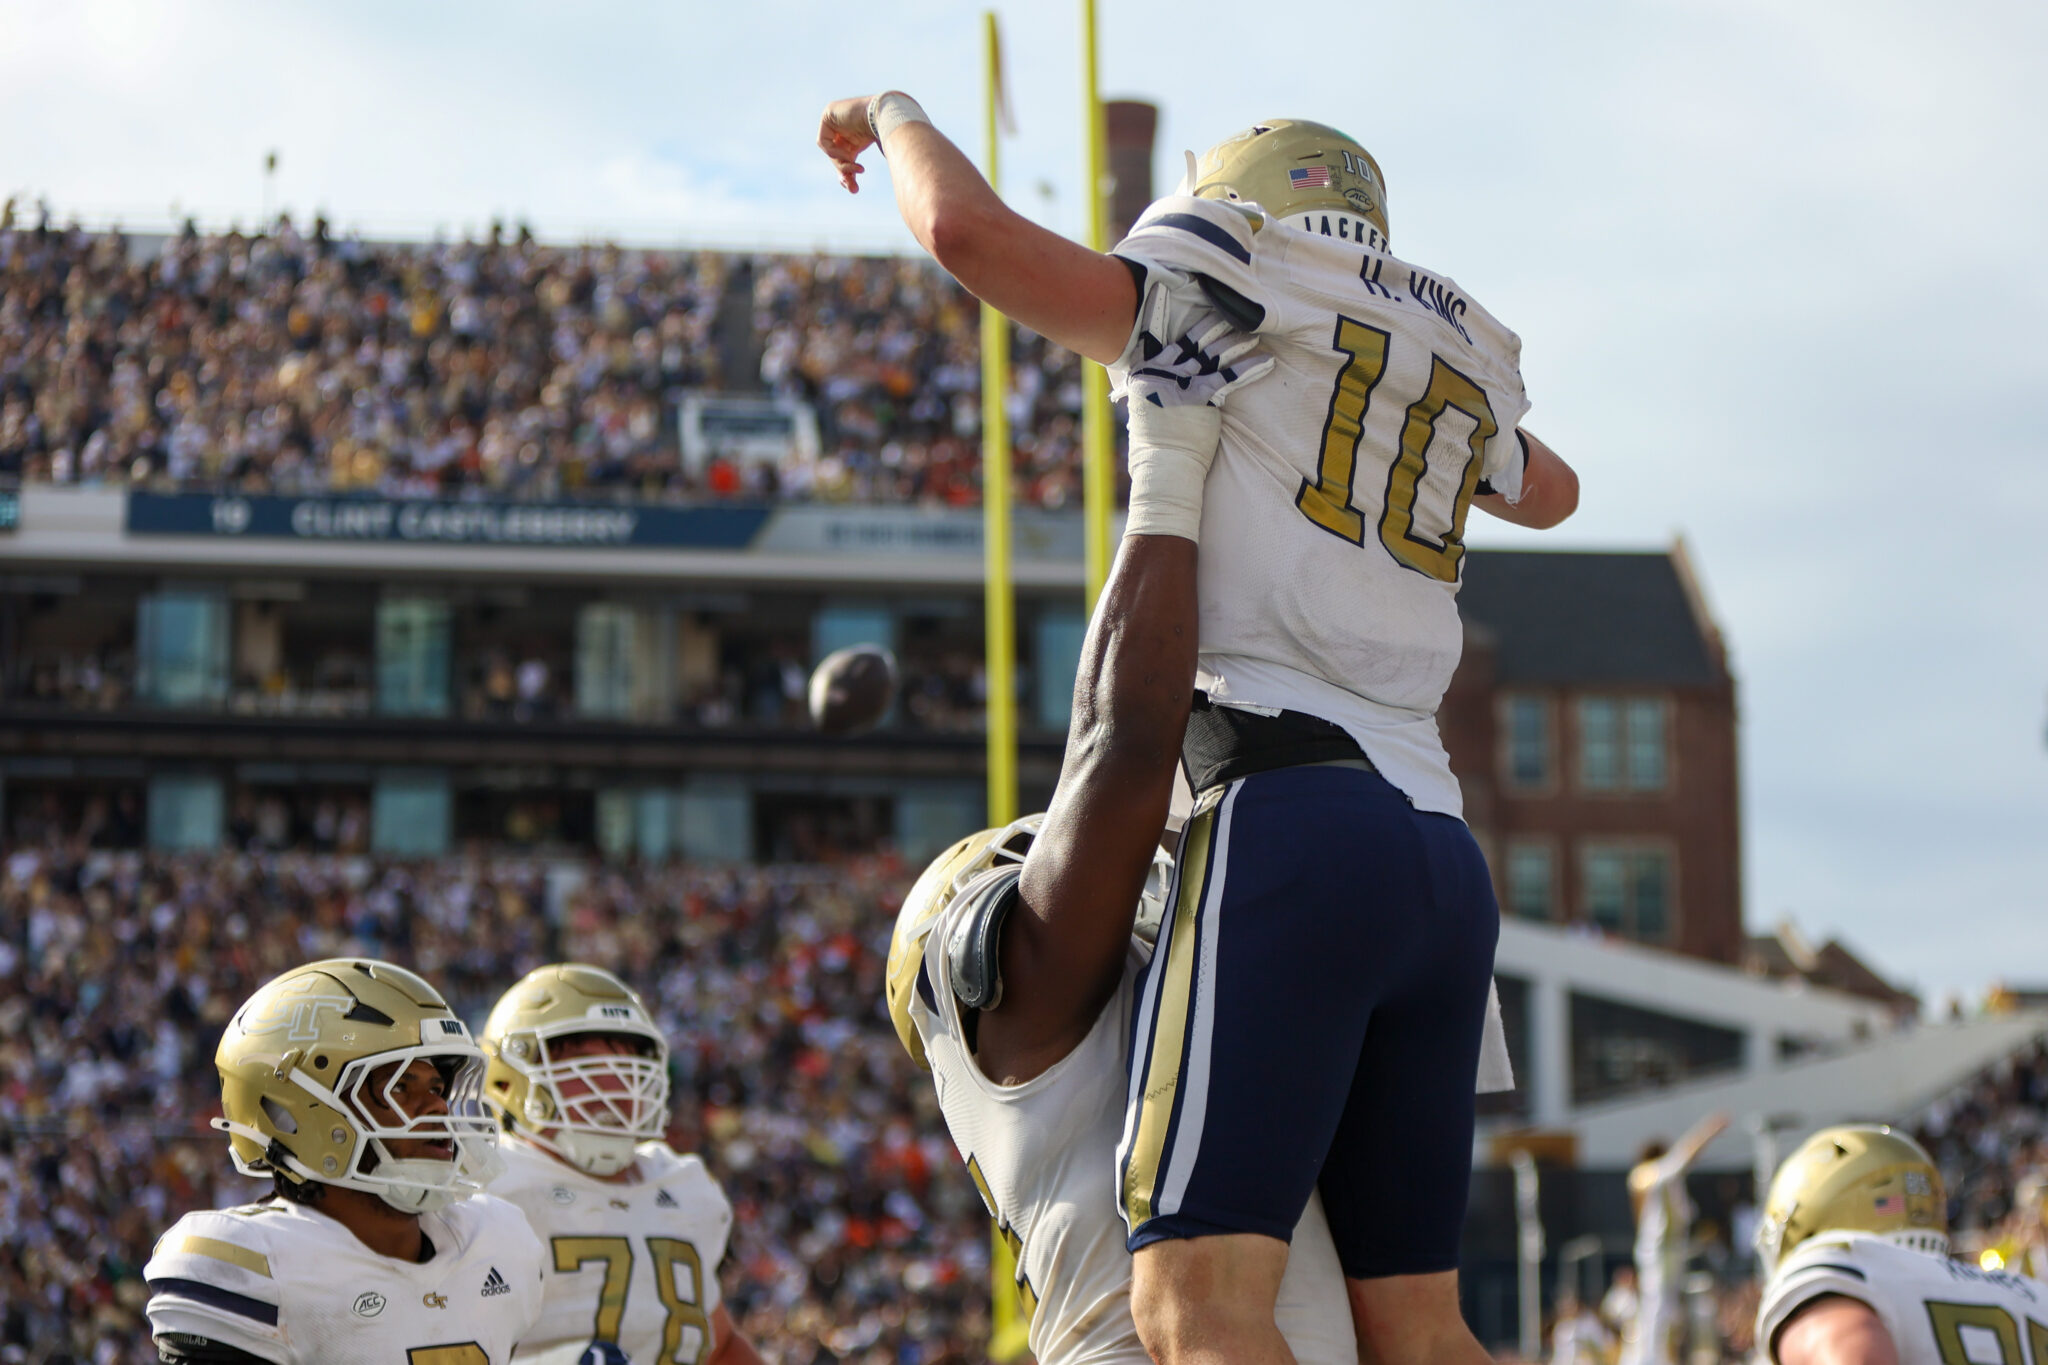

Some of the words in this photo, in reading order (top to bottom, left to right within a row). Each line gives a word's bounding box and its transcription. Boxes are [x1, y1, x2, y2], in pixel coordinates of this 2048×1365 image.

[1342, 149, 1372, 184] 10
[1304, 215, 1392, 255] JACKET
[1409, 270, 1473, 346] KING
[1295, 313, 1499, 584] 10
[291, 501, 394, 538] CLINT
[398, 502, 638, 543] CASTLEBERRY
[358, 1295, 381, 1313] ACC
[481, 1284, 511, 1297] adidas
[550, 1236, 710, 1365] 78
